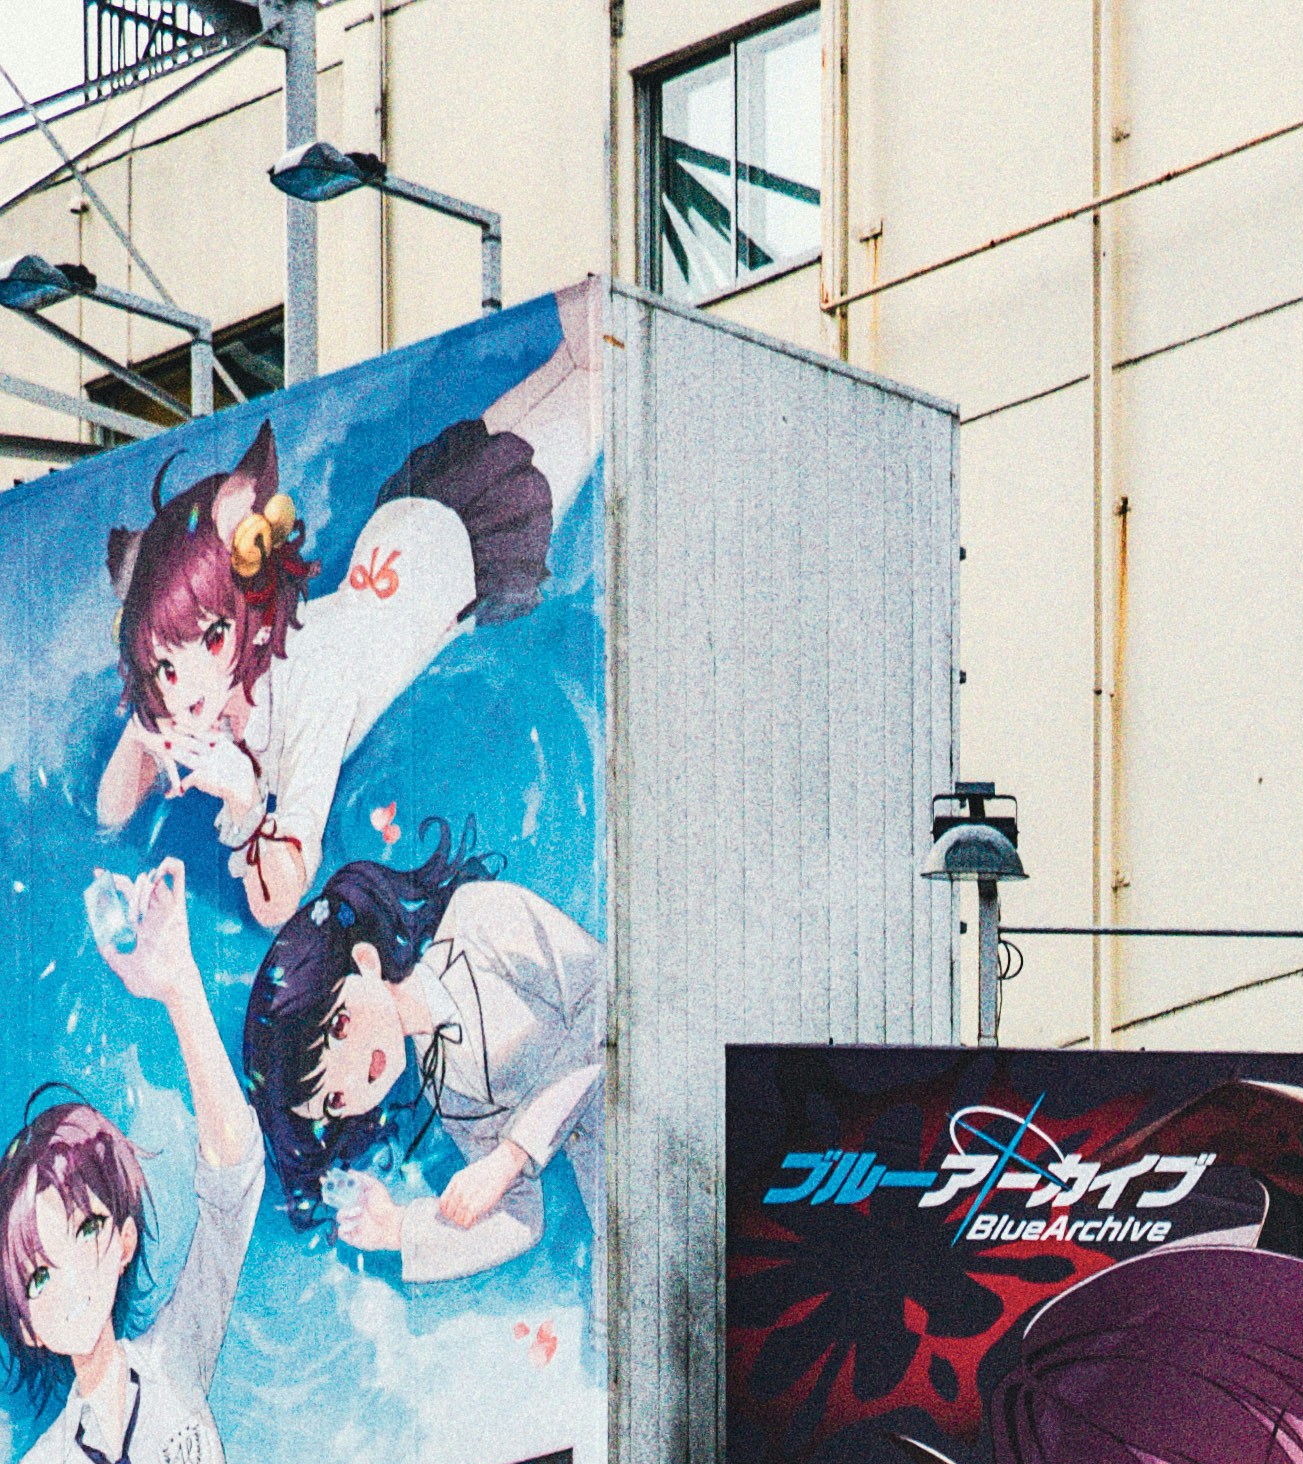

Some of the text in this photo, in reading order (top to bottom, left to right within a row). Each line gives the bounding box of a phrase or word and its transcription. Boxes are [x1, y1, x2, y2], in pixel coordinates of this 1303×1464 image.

[763, 1149, 1216, 1209] ブルーアーカイブ
[966, 1214, 1172, 1243] BlueArchive
